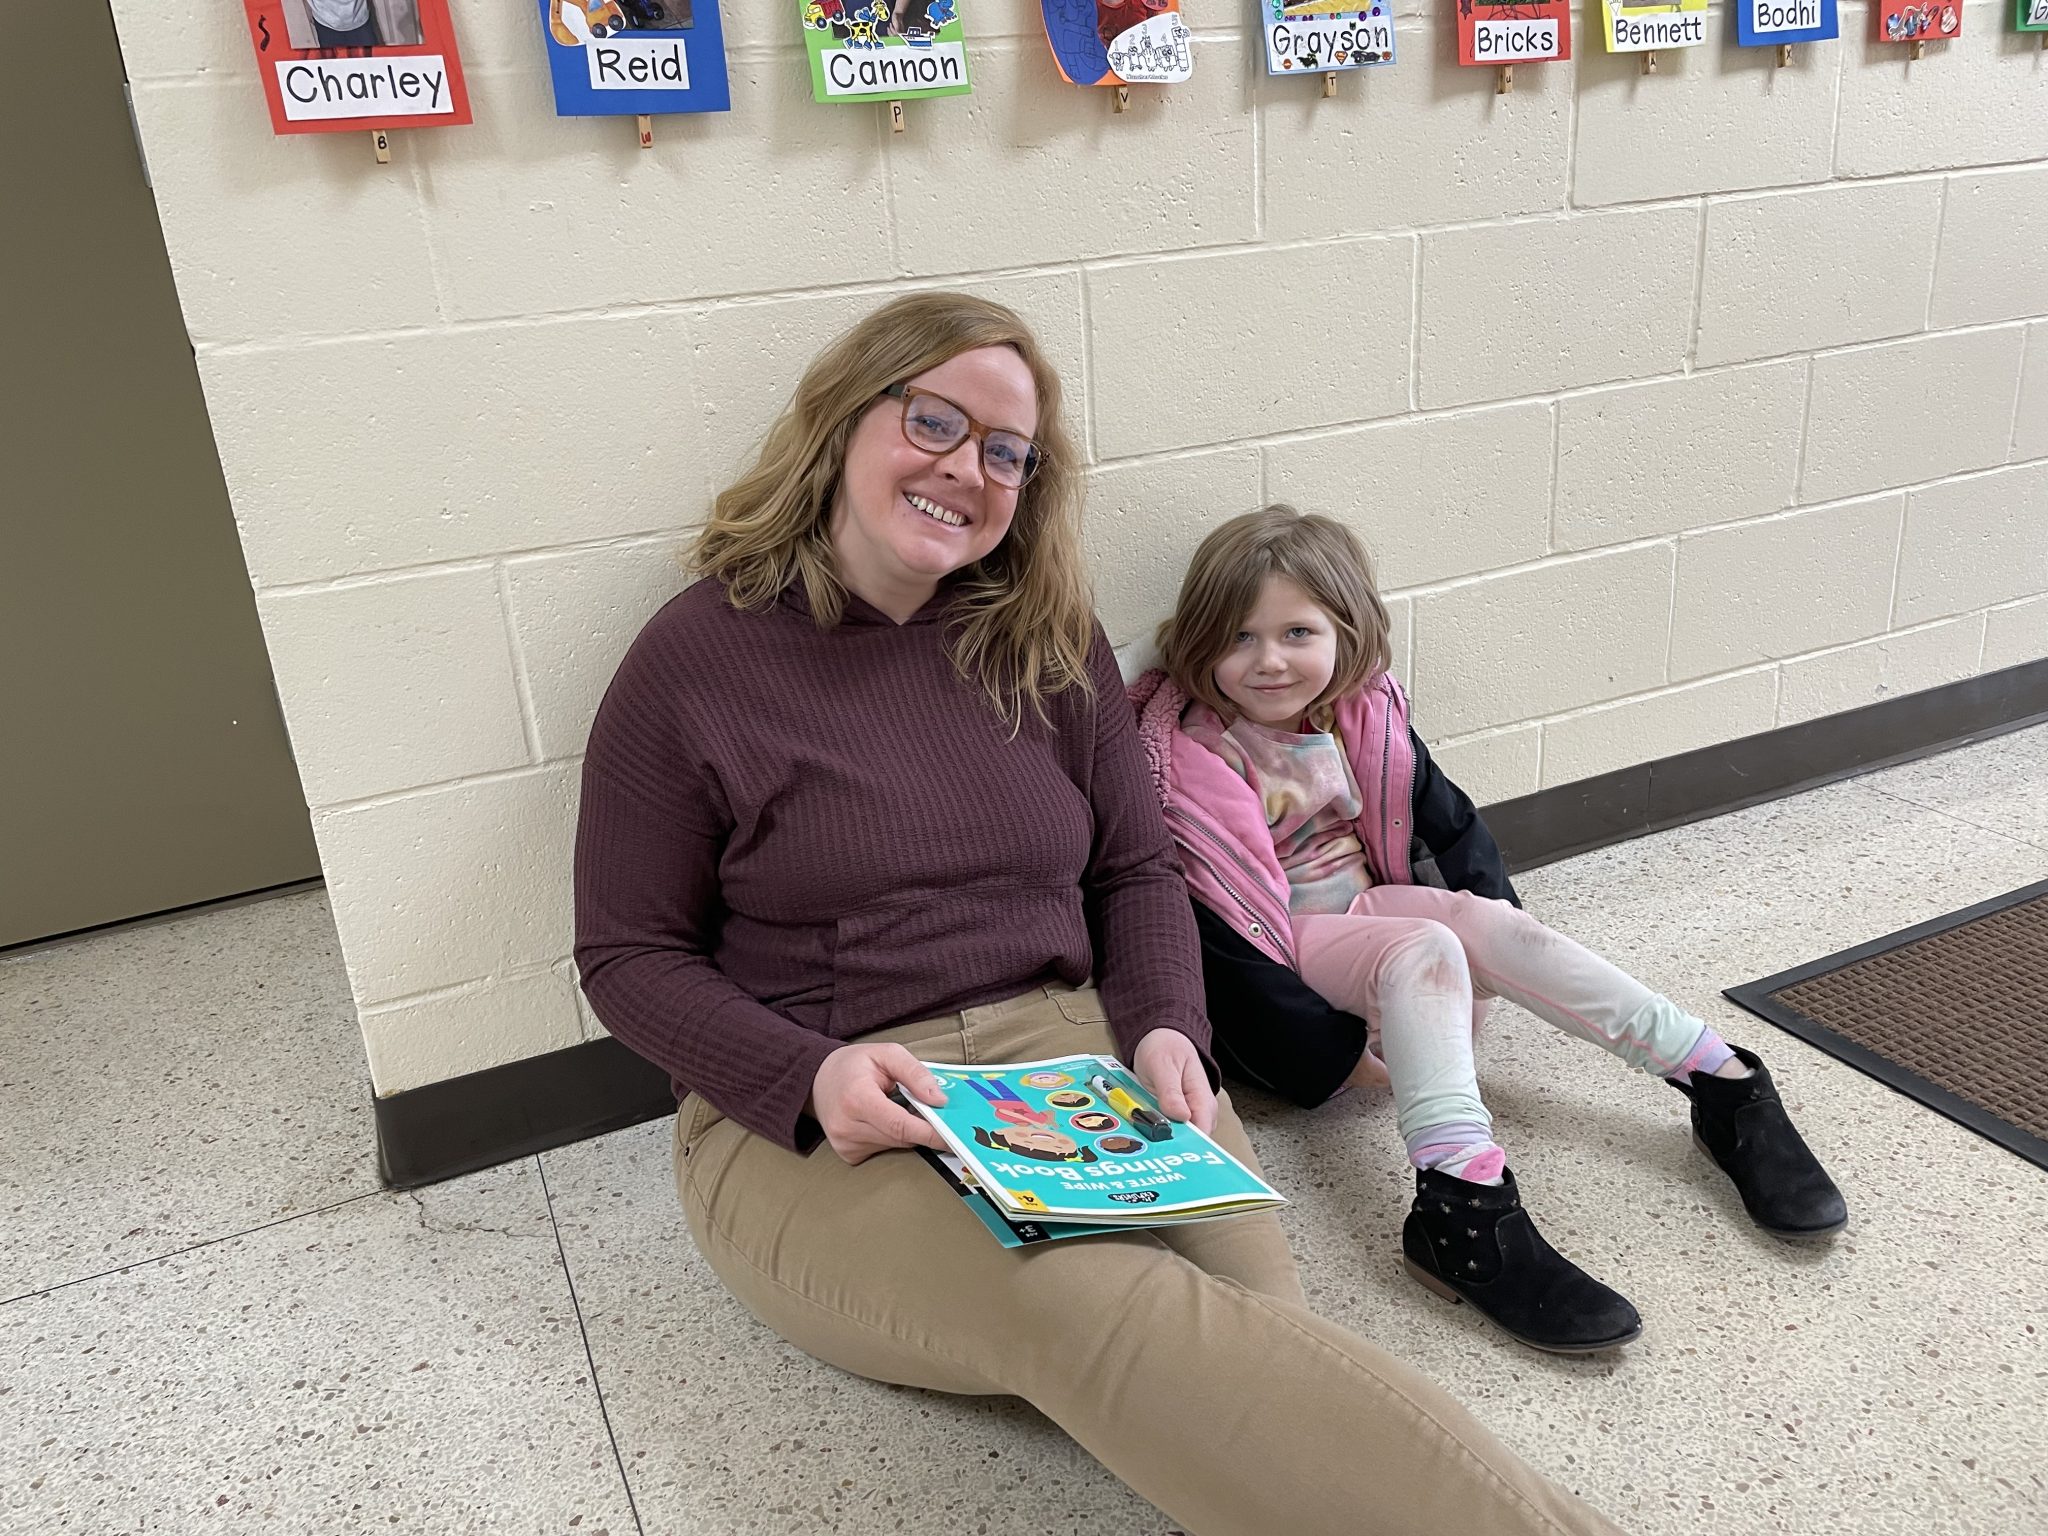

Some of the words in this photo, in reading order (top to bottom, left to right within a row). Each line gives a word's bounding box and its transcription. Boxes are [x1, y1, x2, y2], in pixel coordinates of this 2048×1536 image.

[1757, 0, 1816, 28] Bodhi
[1141, 23, 1148, 35] 3
[1615, 16, 1702, 45] Bennett
[1129, 33, 1136, 45] 2
[1273, 24, 1388, 63] Grayson
[1477, 25, 1554, 54] Bricks
[596, 43, 682, 83] Reid
[829, 53, 959, 89] Cannon
[286, 64, 442, 109] Charley
[1328, 76, 1336, 87] T
[1120, 91, 1129, 104] V
[893, 106, 902, 123] P
[989, 1161, 1085, 1181] Book
[1083, 1151, 1226, 1177] Feelings
[1060, 1181, 1110, 1191] WIPE
[1111, 1180, 1123, 1189] &
[1128, 1172, 1187, 1189] WRITE
[1018, 1224, 1037, 1233] 3+
